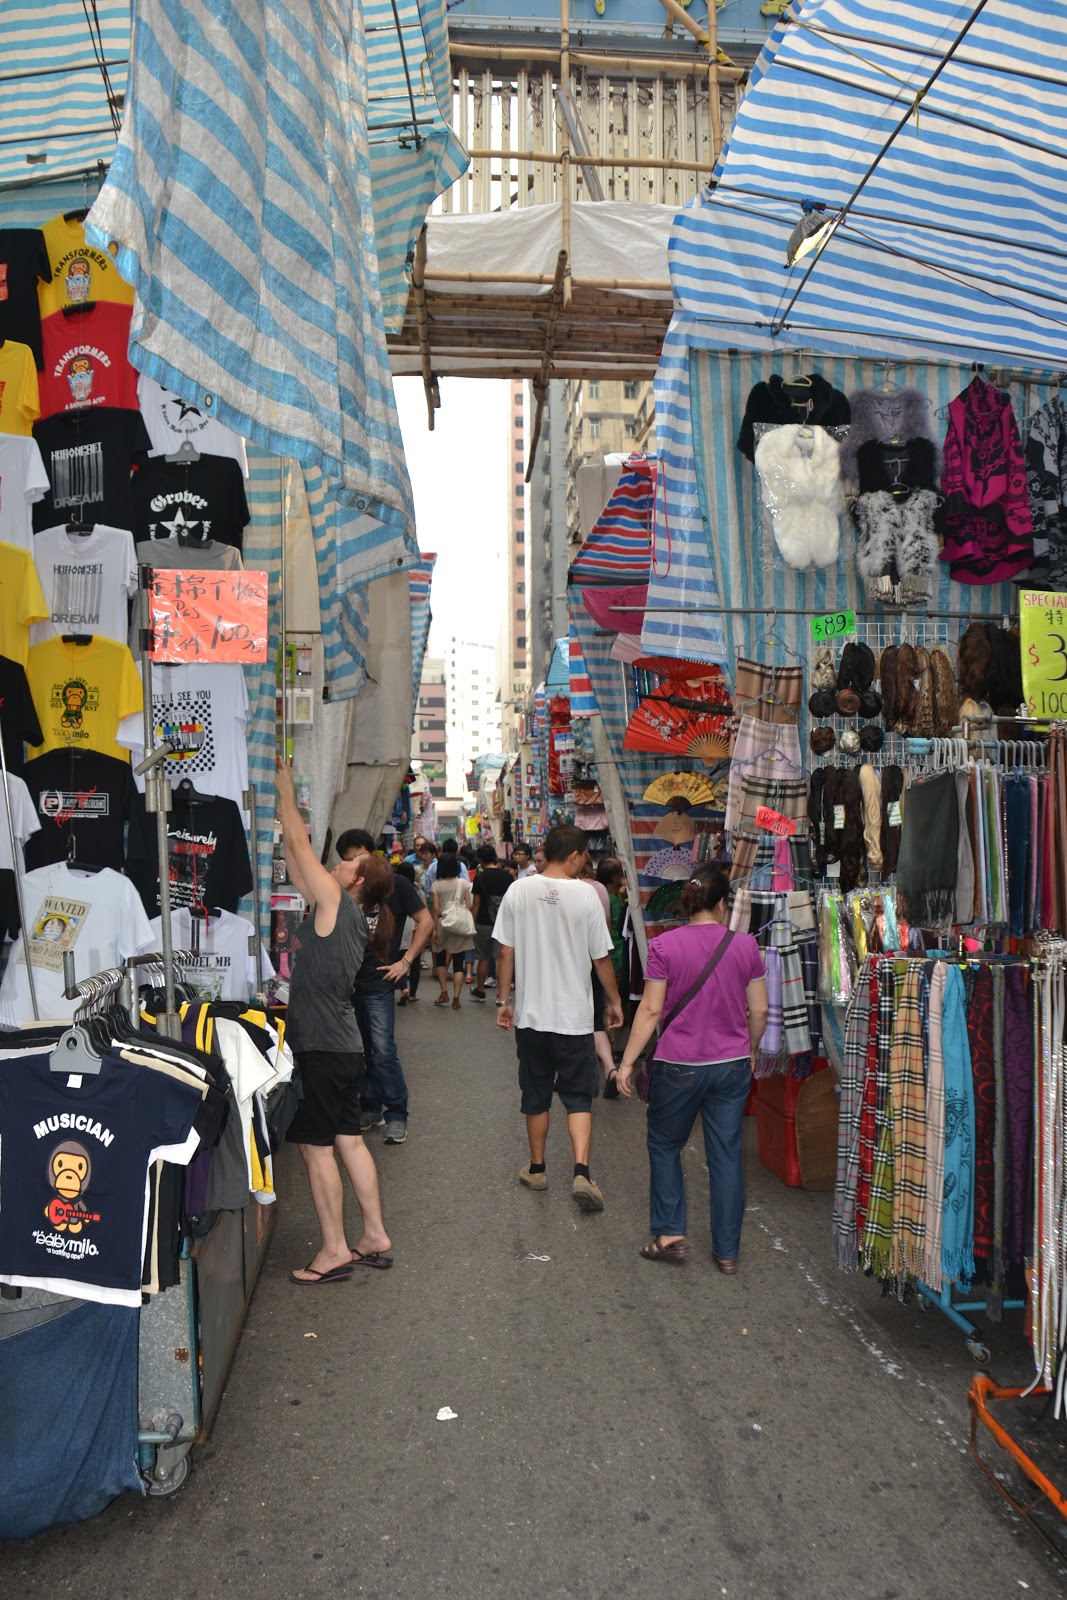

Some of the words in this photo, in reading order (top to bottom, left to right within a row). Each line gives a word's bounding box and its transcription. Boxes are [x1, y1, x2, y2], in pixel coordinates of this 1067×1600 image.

[54, 248, 108, 278] TRANSFORMERS
[54, 345, 111, 377] TRANSFORMERS
[54, 490, 104, 509] DREAM
[51, 612, 100, 625] DREAM
[178, 691, 192, 701] SEE
[195, 690, 211, 700] YOU
[167, 824, 217, 850] Leisurely
[44, 900, 86, 916] WANTED
[214, 956, 231, 967] MB
[33, 1113, 114, 1148] MUSICIAN
